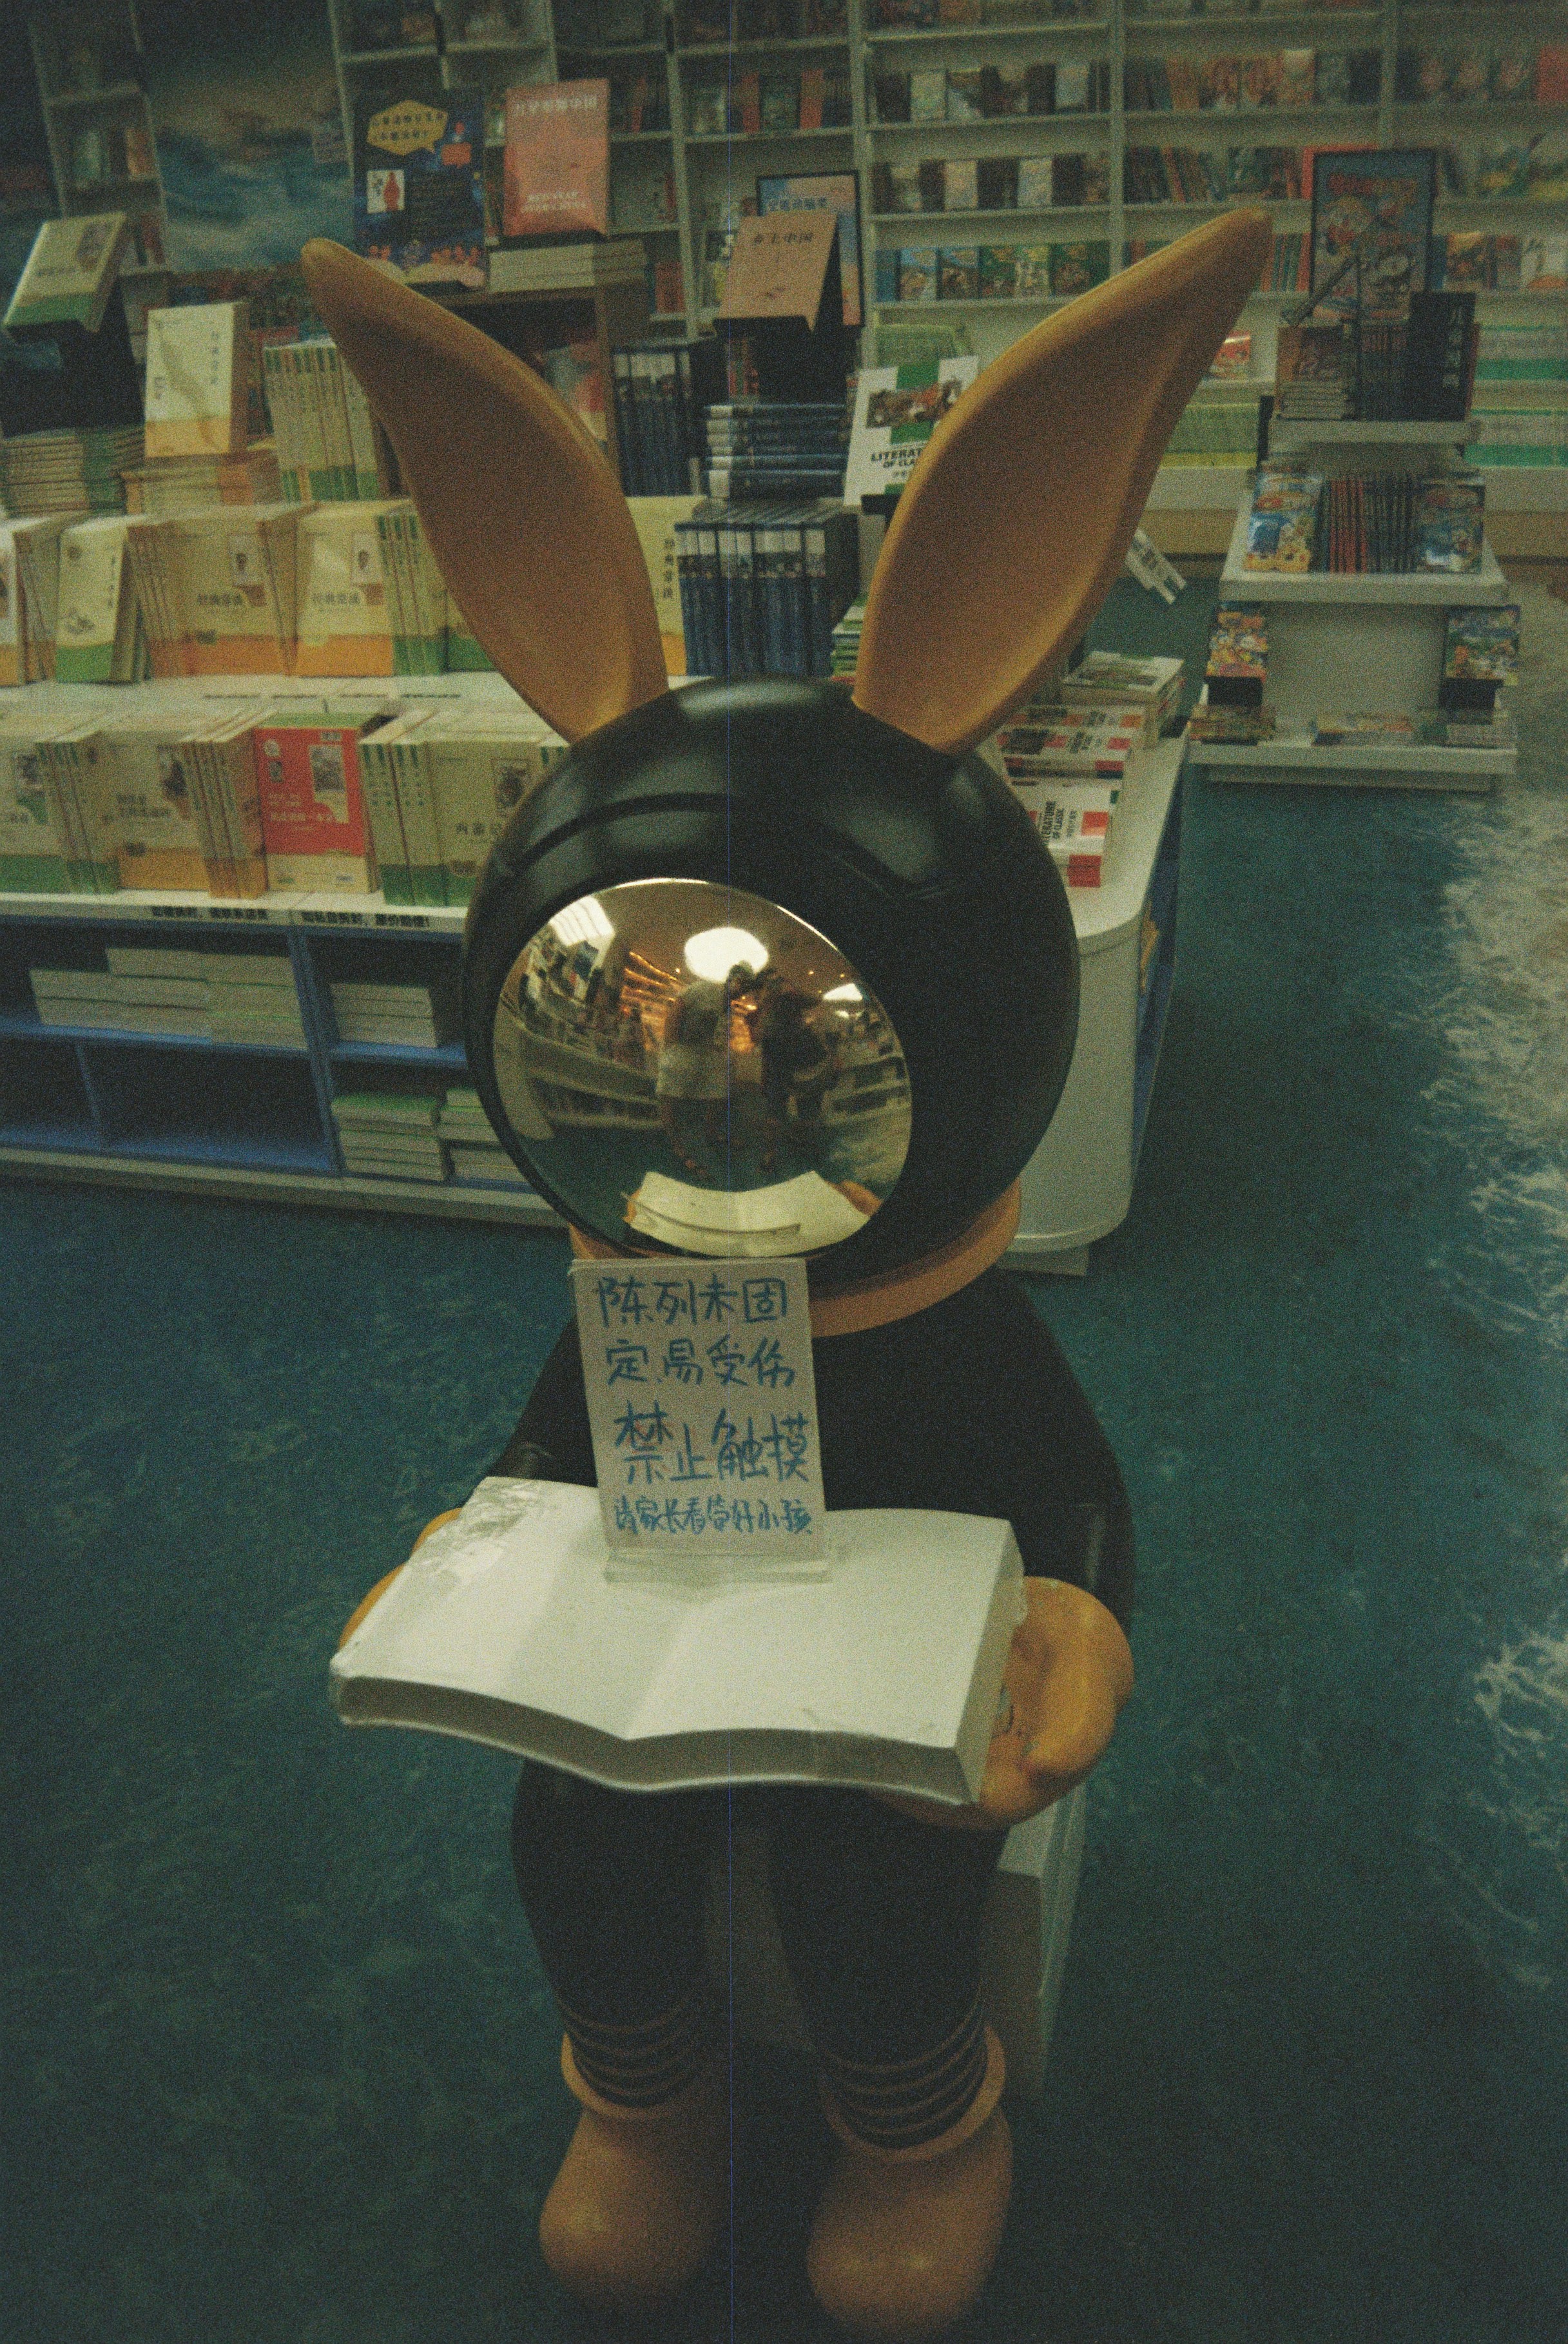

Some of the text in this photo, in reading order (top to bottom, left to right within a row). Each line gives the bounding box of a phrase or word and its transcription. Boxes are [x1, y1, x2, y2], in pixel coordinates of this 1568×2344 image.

[871, 448, 923, 462] LITERAT
[597, 1273, 788, 1327] 陈列未固
[614, 1400, 809, 1485] 禁止触摸
[614, 1494, 813, 1535] 请家长看管好小孩
